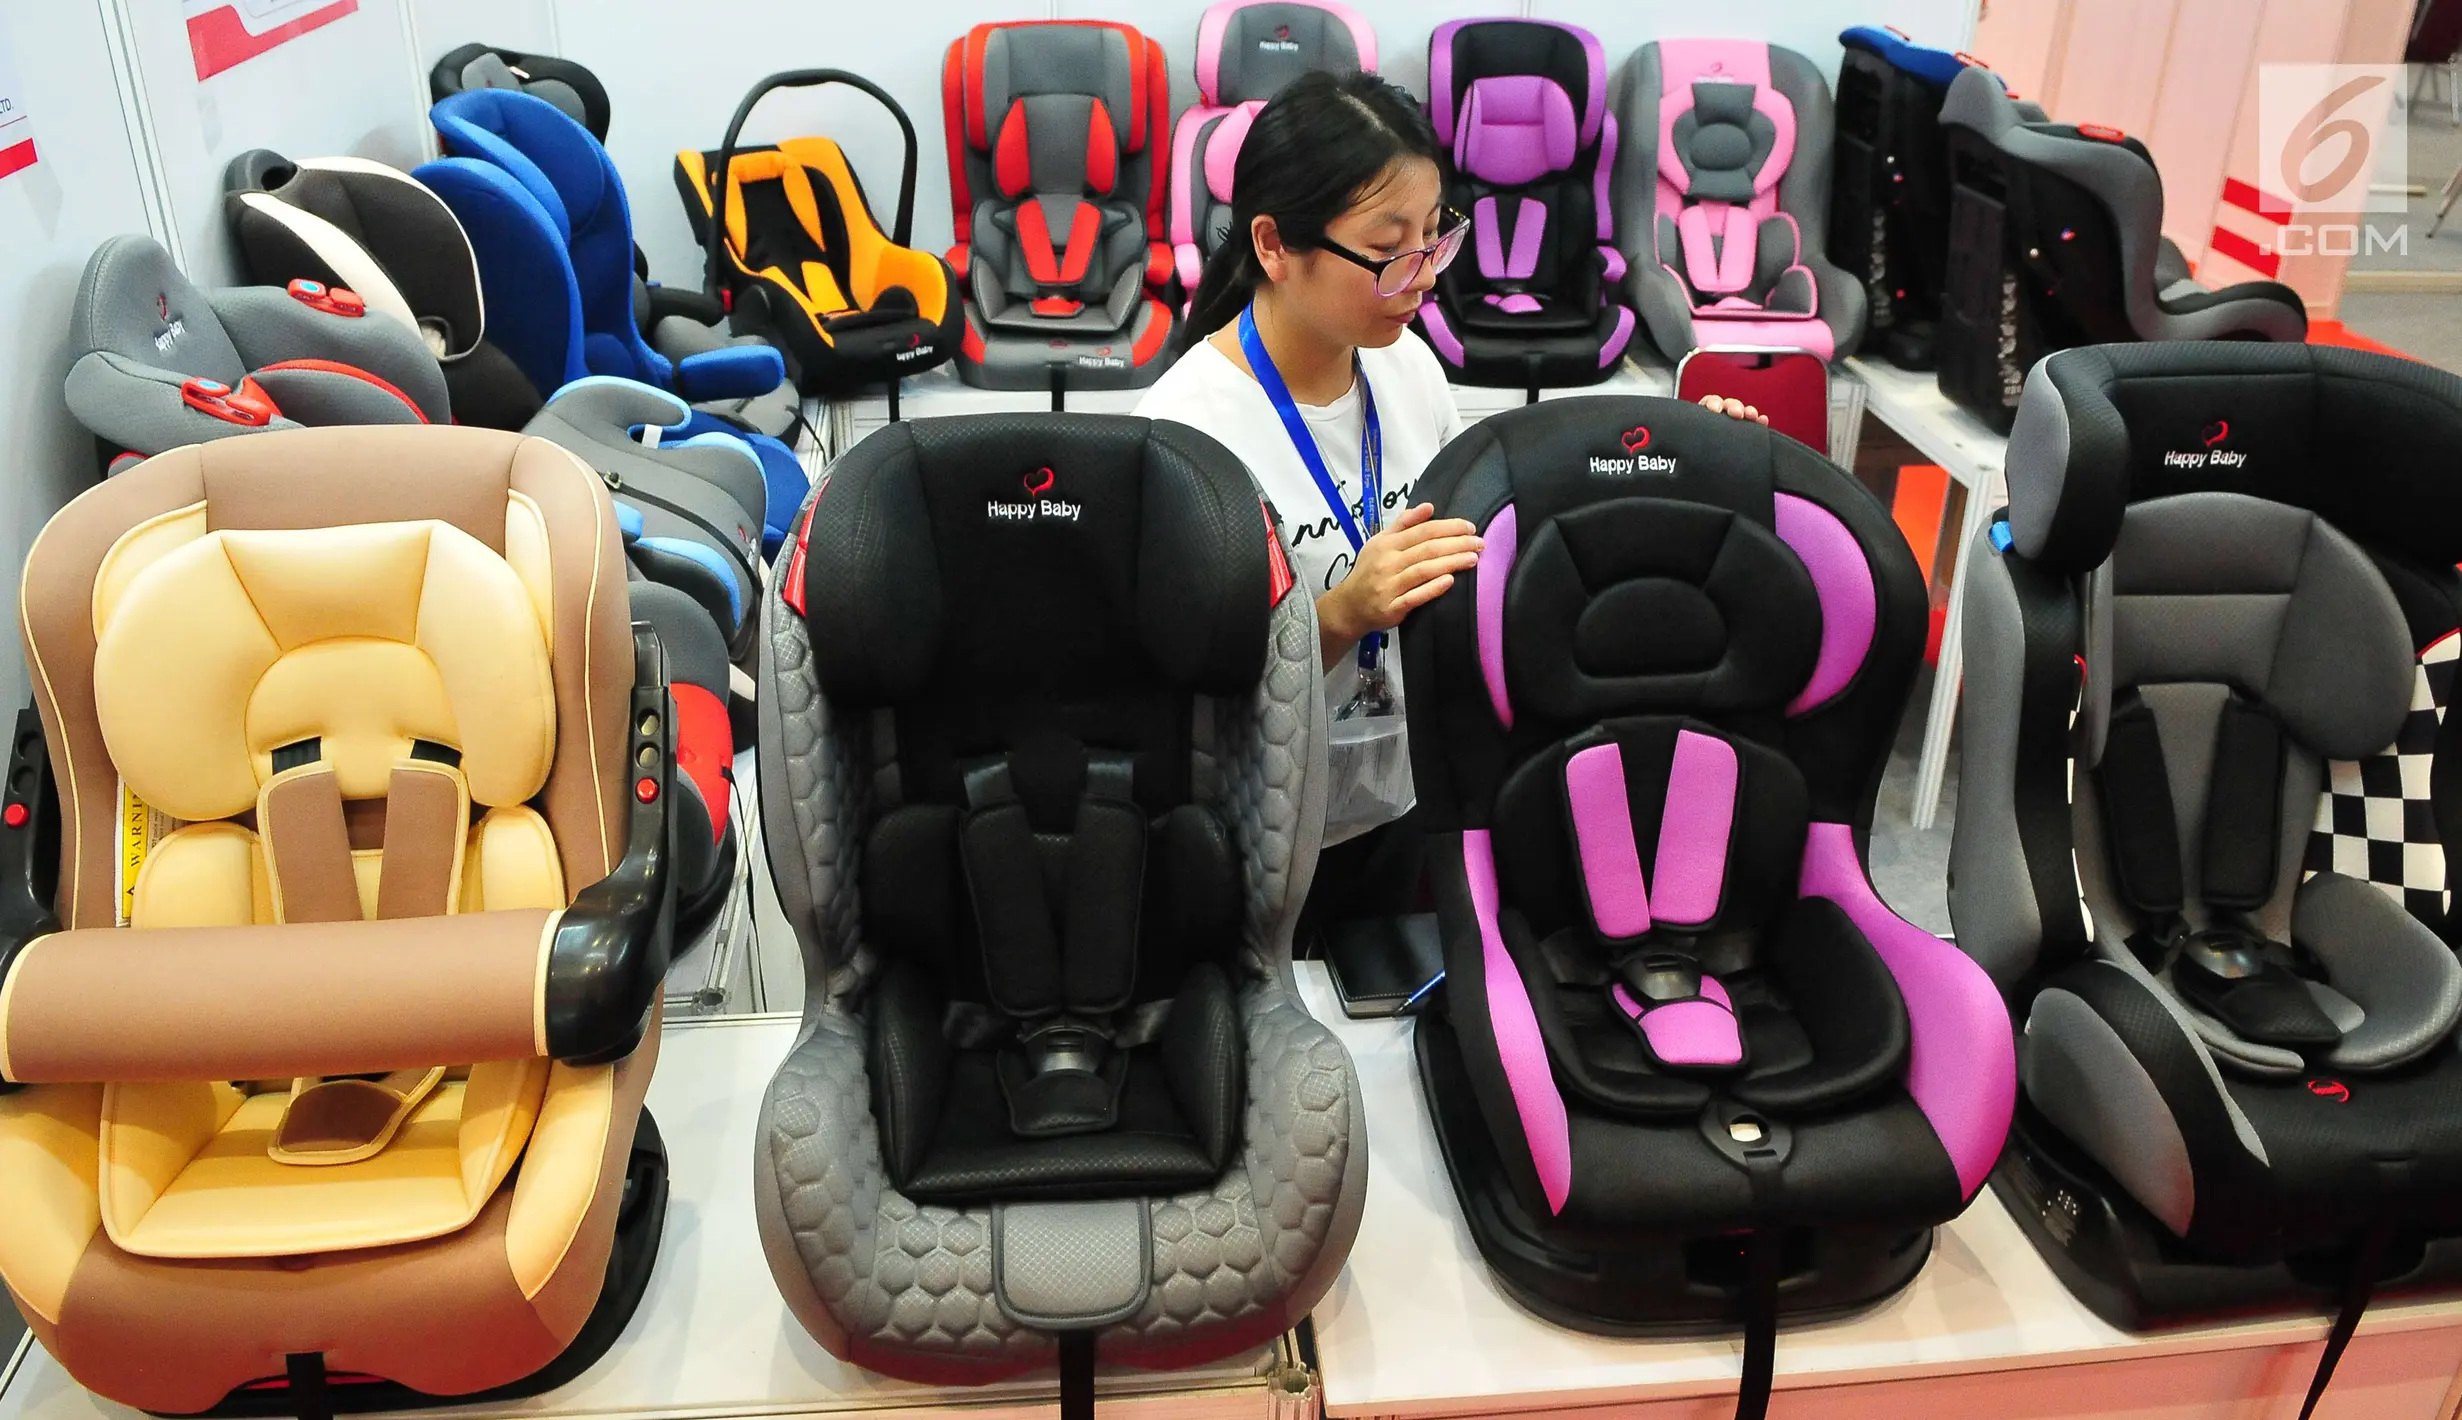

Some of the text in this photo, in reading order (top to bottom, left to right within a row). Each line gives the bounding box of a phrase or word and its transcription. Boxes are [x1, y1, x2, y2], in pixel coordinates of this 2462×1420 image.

[1589, 455, 1677, 475] Happy Baby
[2164, 449, 2247, 469] Happy Baby
[987, 499, 1081, 521] Happy Baby
